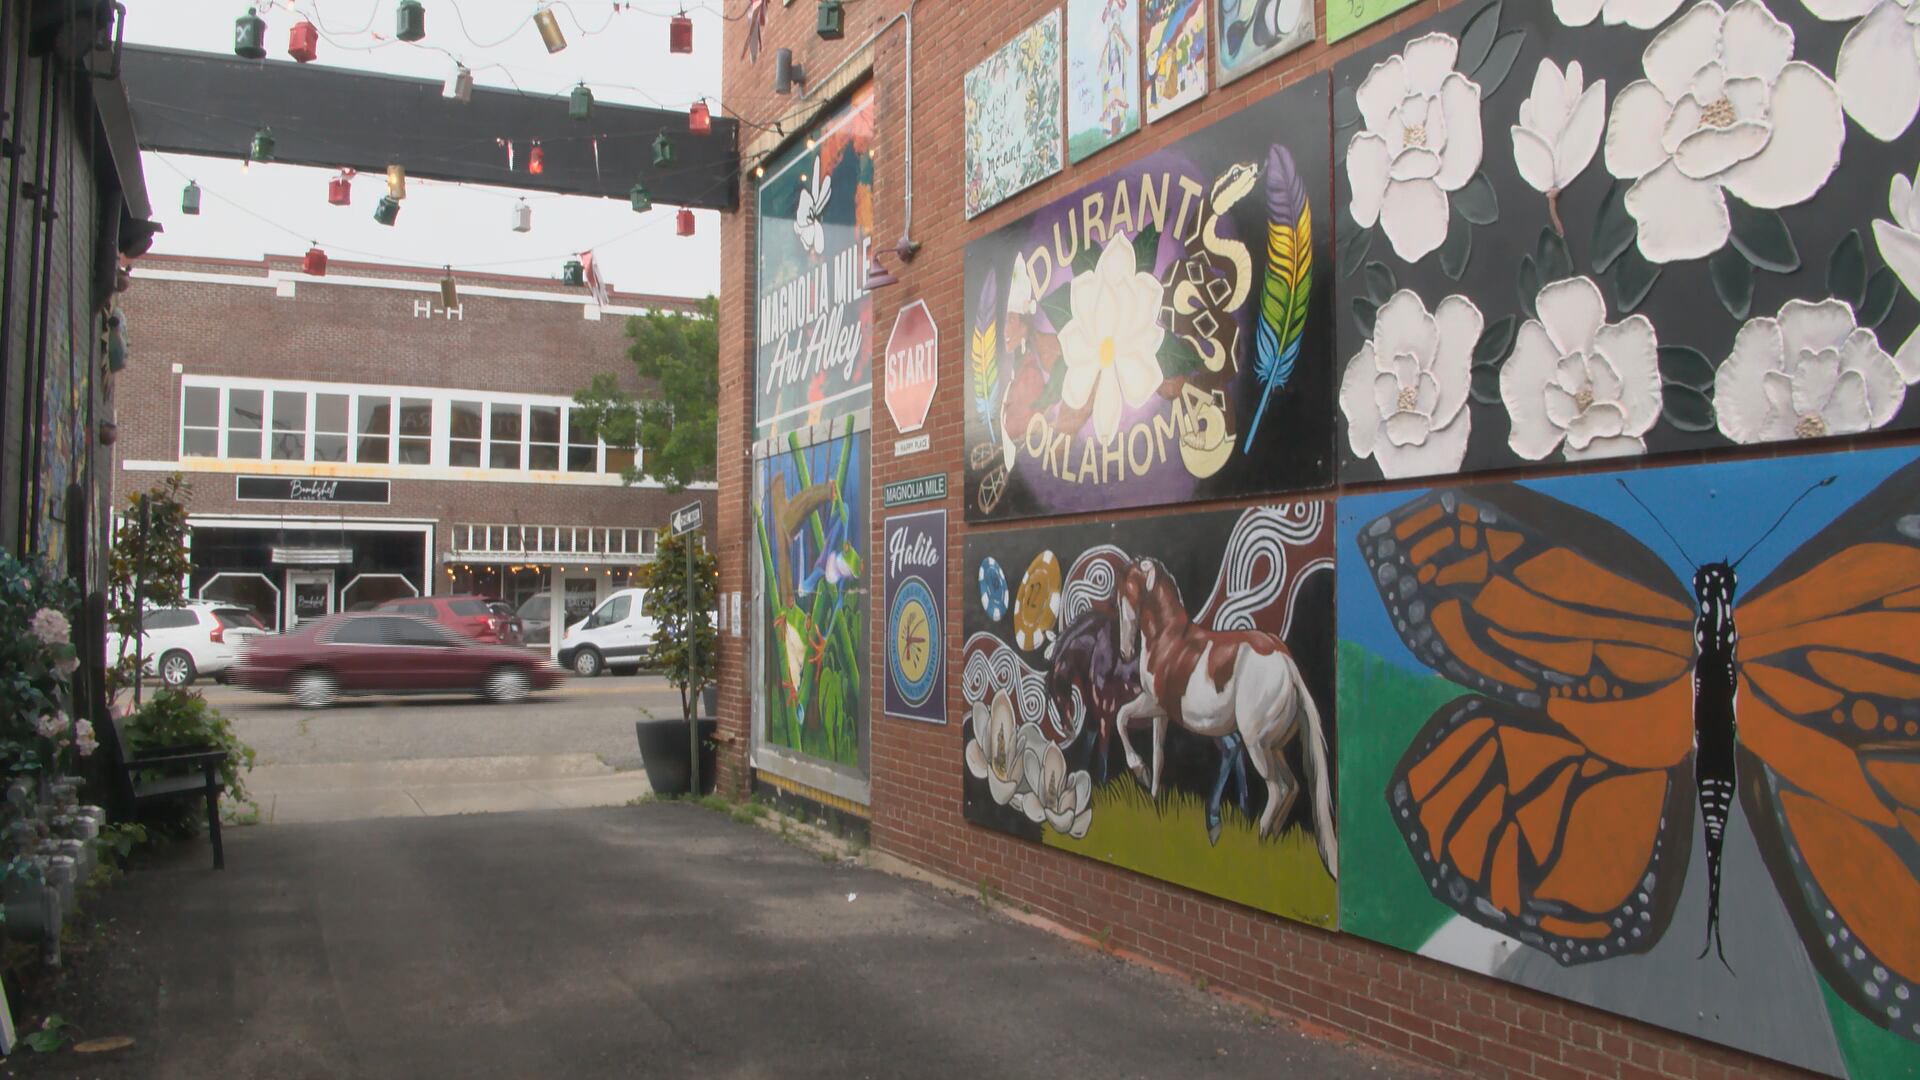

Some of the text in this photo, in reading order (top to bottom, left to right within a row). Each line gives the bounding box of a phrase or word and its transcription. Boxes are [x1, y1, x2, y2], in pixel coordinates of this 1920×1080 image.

[1026, 173, 1203, 301] DURANT
[761, 236, 872, 347] MAGNOLIA MILE
[766, 302, 863, 396] Art Alley
[888, 339, 934, 393] START
[1025, 381, 1214, 485] OKLAHOMA
[291, 480, 338, 498] Bombshell
[886, 478, 944, 502] MAGNOLIA MILE
[890, 526, 939, 579] Halito
